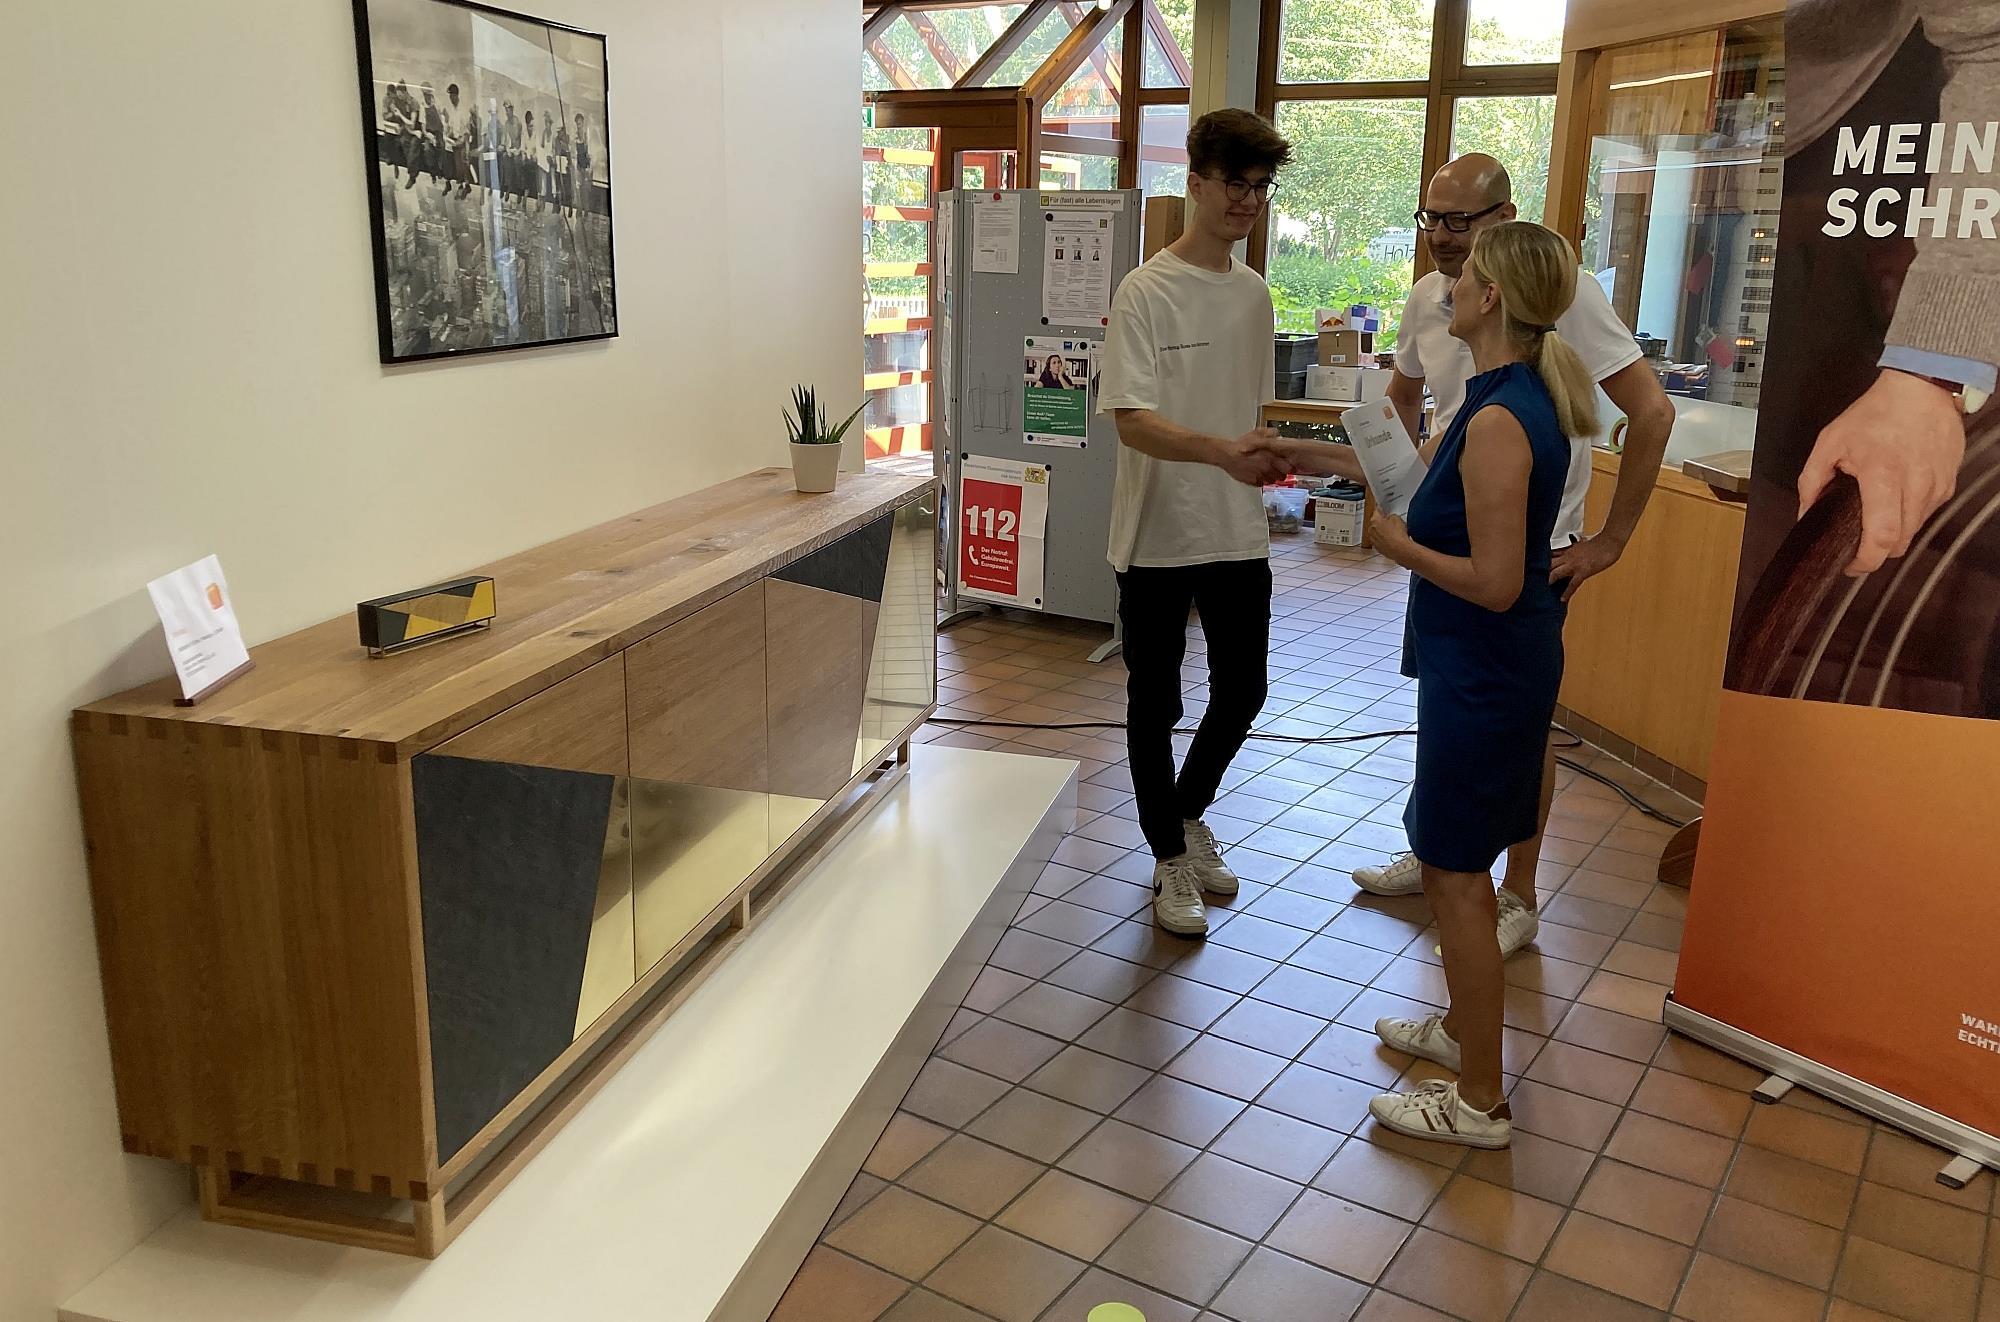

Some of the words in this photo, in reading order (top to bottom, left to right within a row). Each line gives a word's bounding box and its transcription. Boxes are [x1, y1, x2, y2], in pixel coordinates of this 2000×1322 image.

[1832, 121, 1999, 176] MEIN
[1821, 187, 2000, 239] SCHR
[965, 505, 1016, 542] 112
[1961, 1012, 2000, 1037] WAH
